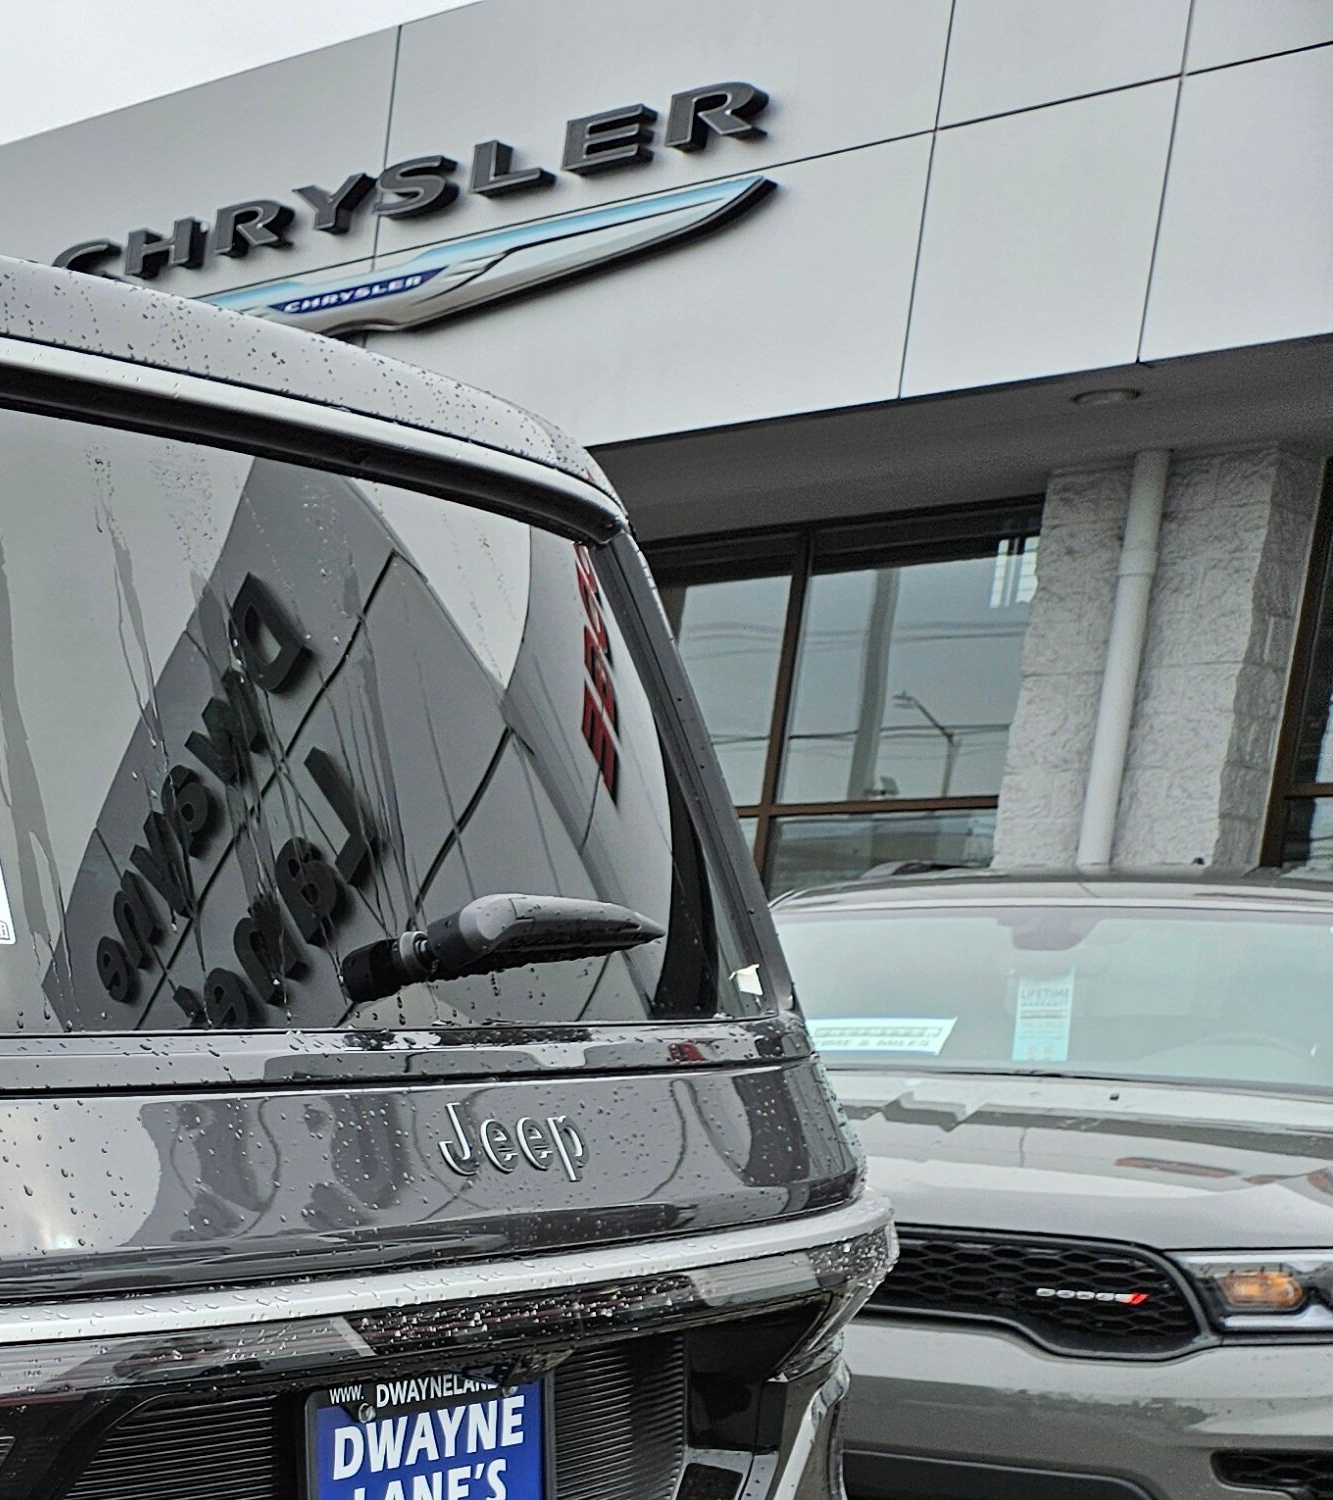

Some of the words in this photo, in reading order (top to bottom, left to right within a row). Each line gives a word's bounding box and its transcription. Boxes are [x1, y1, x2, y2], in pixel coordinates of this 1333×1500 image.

[51, 80, 773, 281] CHRYSLER
[283, 275, 423, 314] CHRYSLER
[437, 1101, 590, 1182] Jeep
[333, 1394, 525, 1480] DWAYNE
